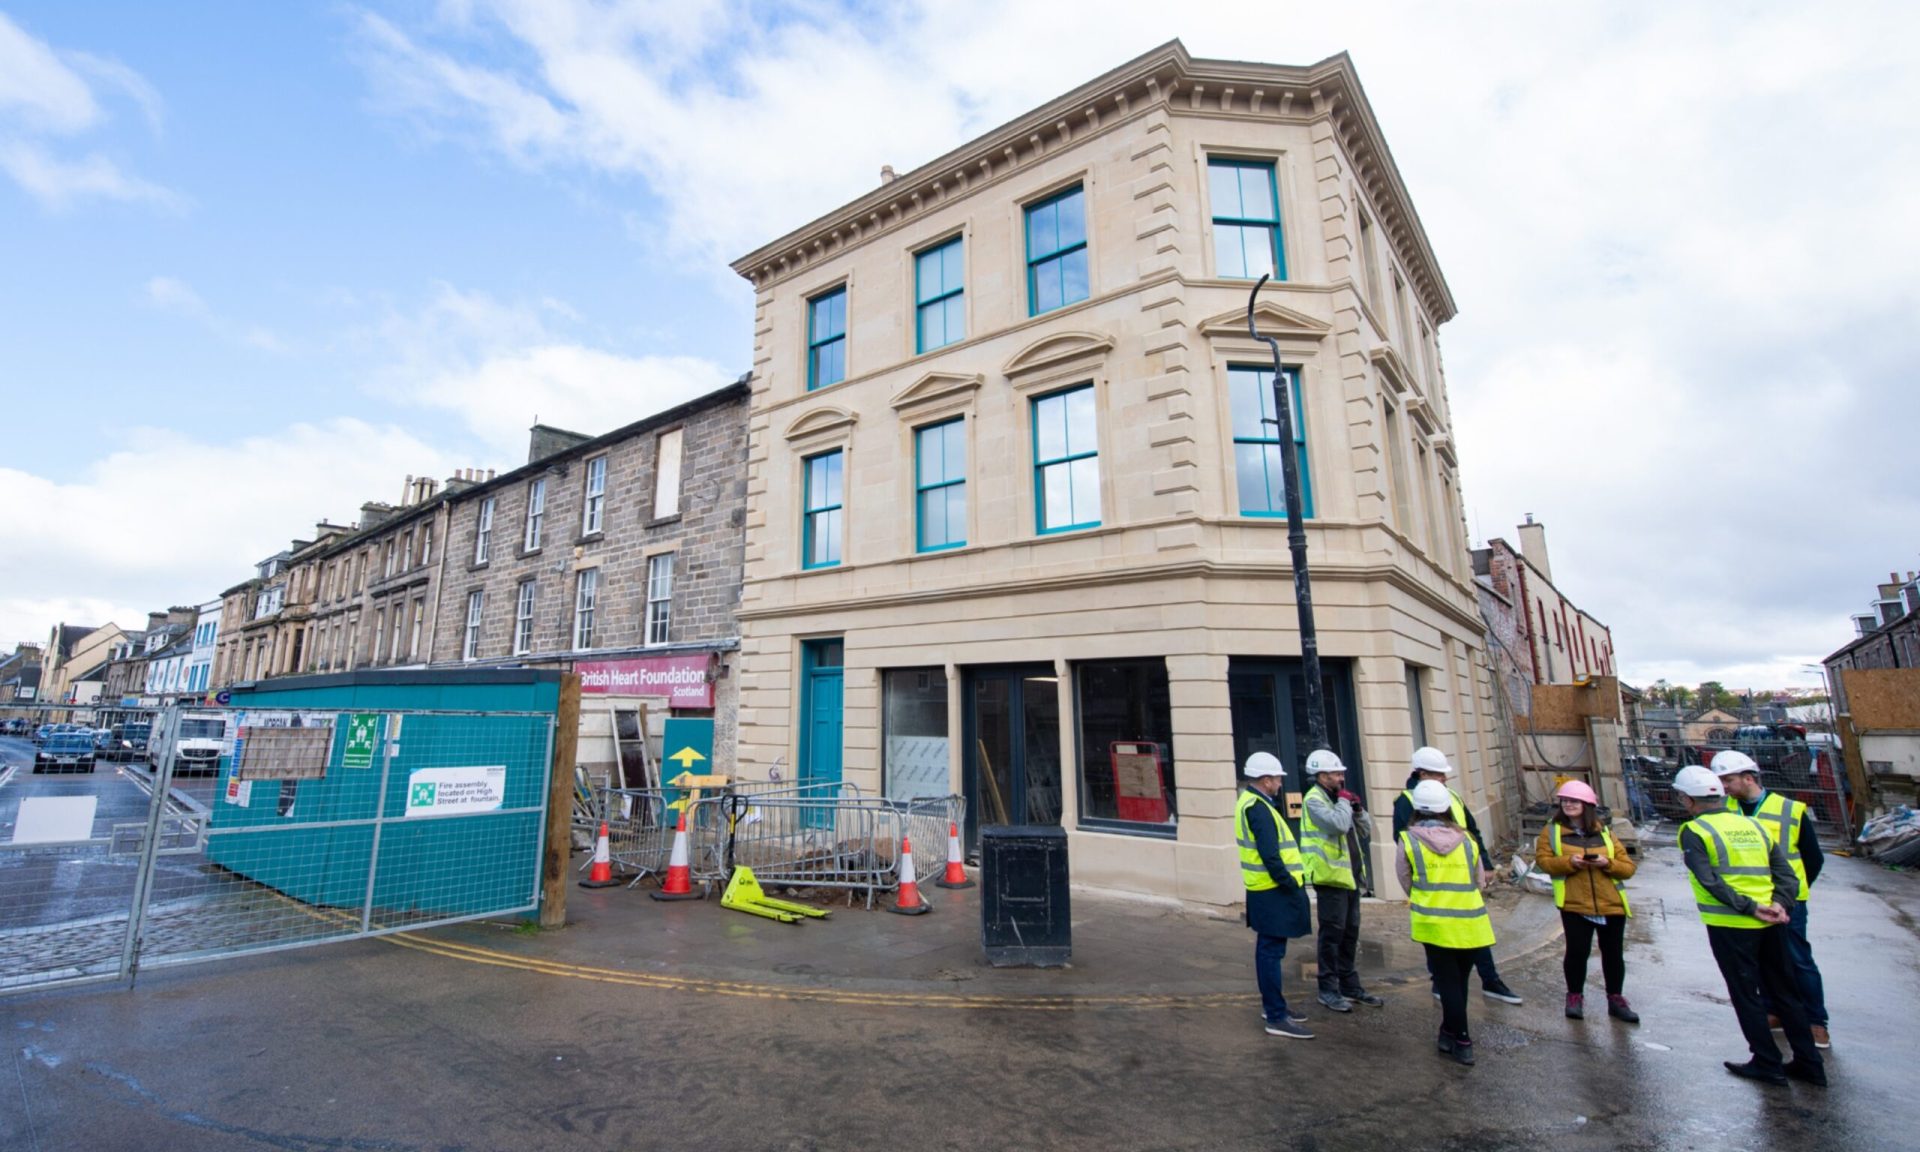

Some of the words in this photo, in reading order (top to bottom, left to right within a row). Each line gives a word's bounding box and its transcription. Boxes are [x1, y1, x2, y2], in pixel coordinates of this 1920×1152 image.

[581, 669, 609, 686] British
[611, 670, 637, 685] Heart
[640, 666, 704, 684] Foundation
[672, 686, 704, 696] Scotland
